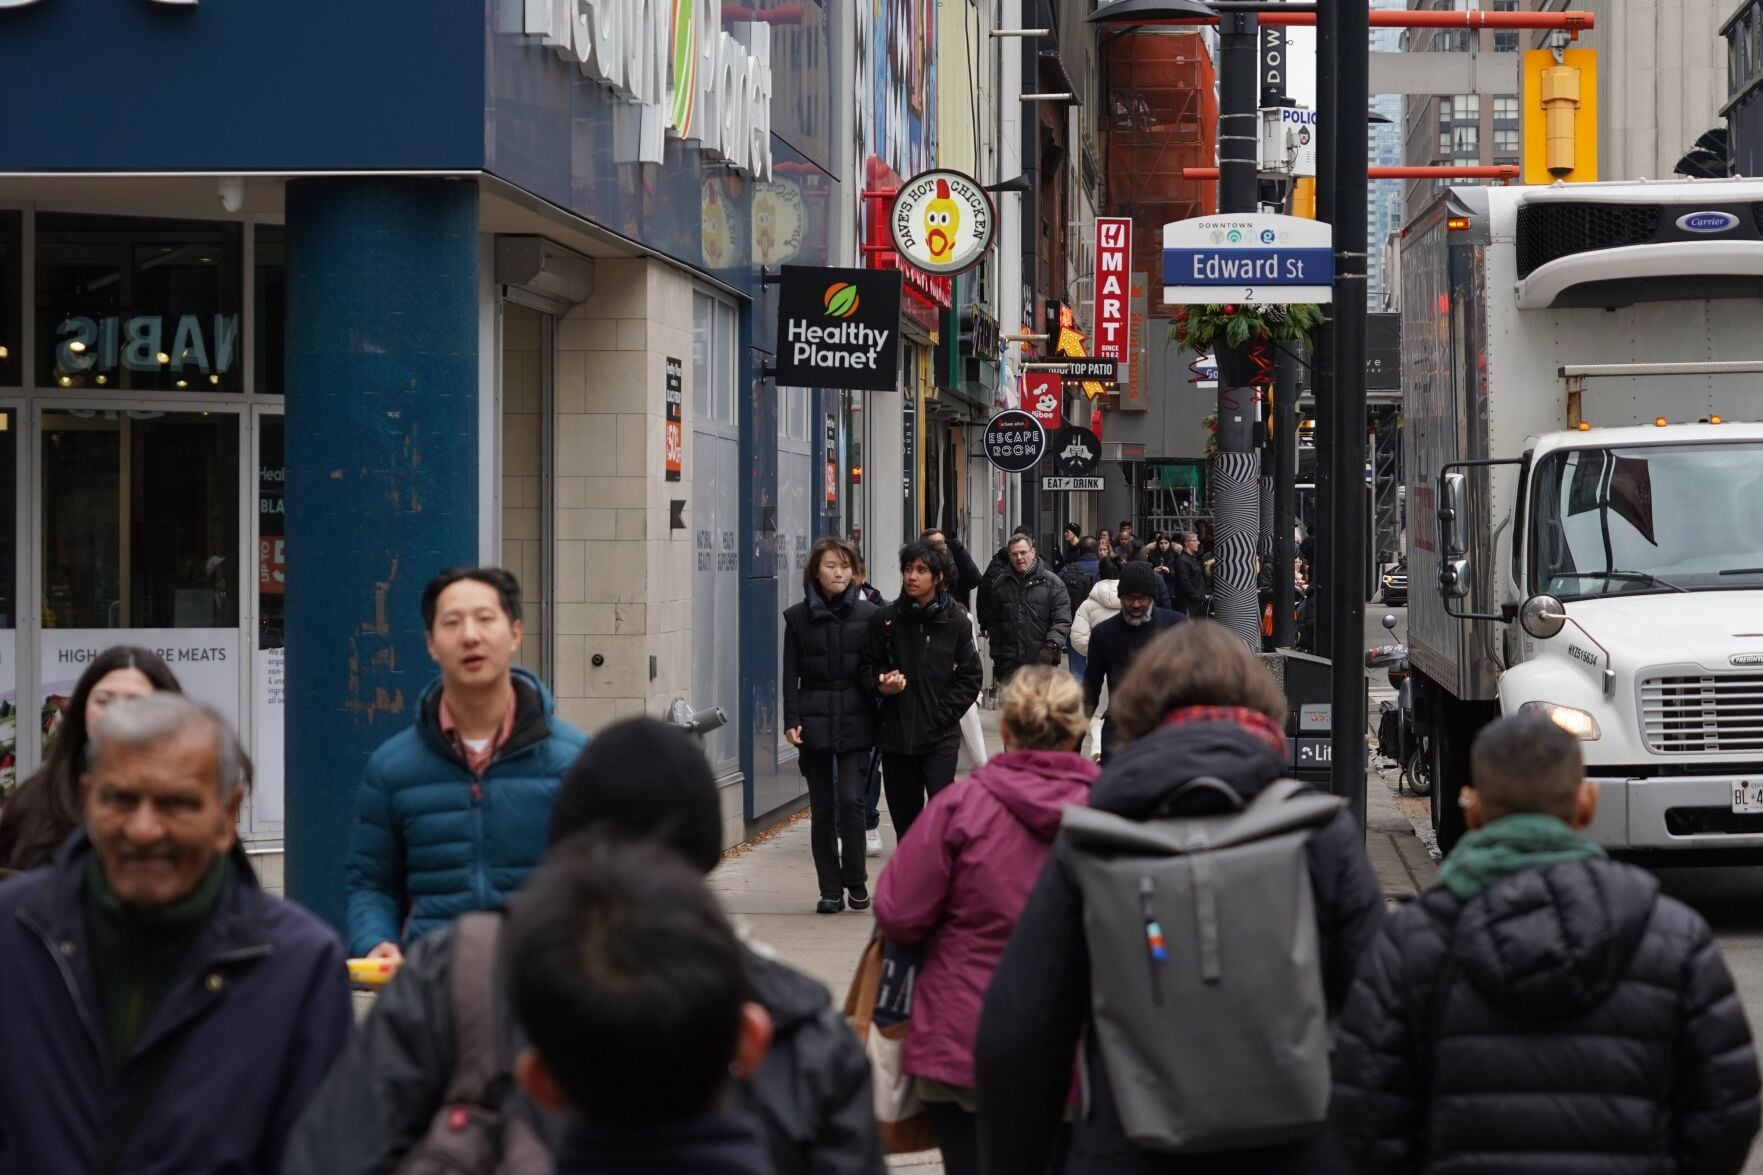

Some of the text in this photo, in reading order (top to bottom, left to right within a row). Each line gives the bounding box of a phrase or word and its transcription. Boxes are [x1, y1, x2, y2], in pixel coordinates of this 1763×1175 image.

[898, 180, 986, 249] DAVE'S HOT CHICKEN
[1691, 217, 1725, 226] Carrier
[1193, 254, 1304, 279] Edward St
[1101, 252, 1122, 342] MART
[1245, 288, 1253, 300] 2
[788, 318, 888, 351] Healthy
[793, 343, 877, 369] Planet
[1088, 363, 1113, 375] PATIO
[988, 431, 1039, 444] ESCAPE
[993, 444, 1036, 457] ROOM
[1047, 479, 1099, 489] EAT DRINK
[59, 649, 96, 663] HIGH
[178, 648, 226, 662] MEATS
[1735, 790, 1750, 805] BL
